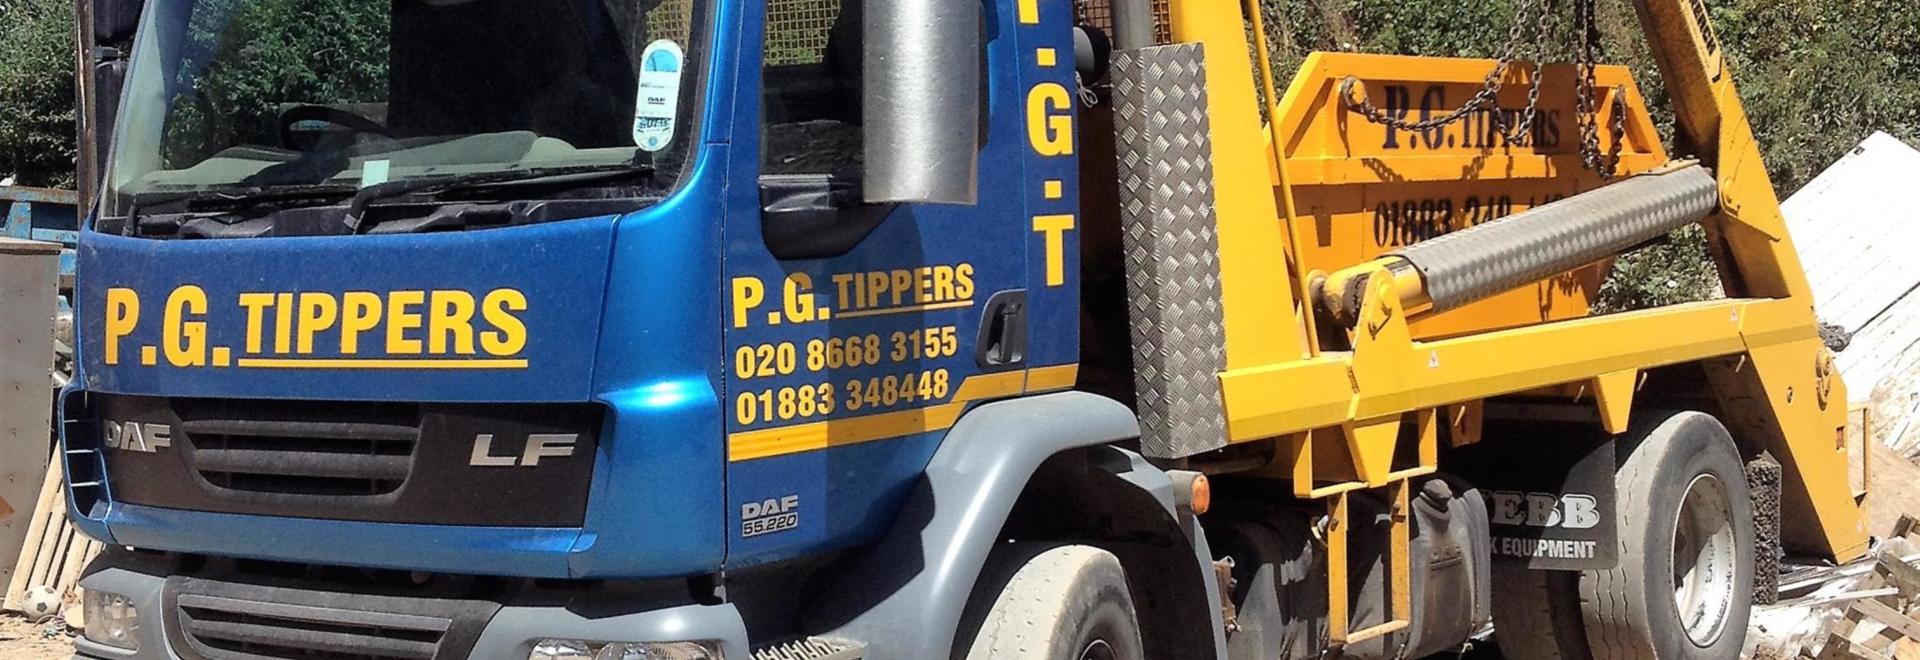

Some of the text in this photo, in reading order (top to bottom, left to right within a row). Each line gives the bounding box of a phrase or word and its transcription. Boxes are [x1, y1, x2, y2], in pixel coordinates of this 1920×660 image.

[1018, 0, 1076, 287] .G.T
[1382, 84, 1455, 150] P.G.
[732, 263, 974, 328] P.G. TIPPERS
[105, 284, 529, 367] P.G. TIPPERS
[736, 326, 957, 379] 020 8668 3155
[737, 368, 949, 425] 01883 348448
[104, 420, 171, 453] DAF
[470, 434, 579, 466] LF
[742, 495, 798, 519] DAF
[743, 514, 797, 535] 55.220
[1502, 538, 1597, 558] EQUIPMENT
